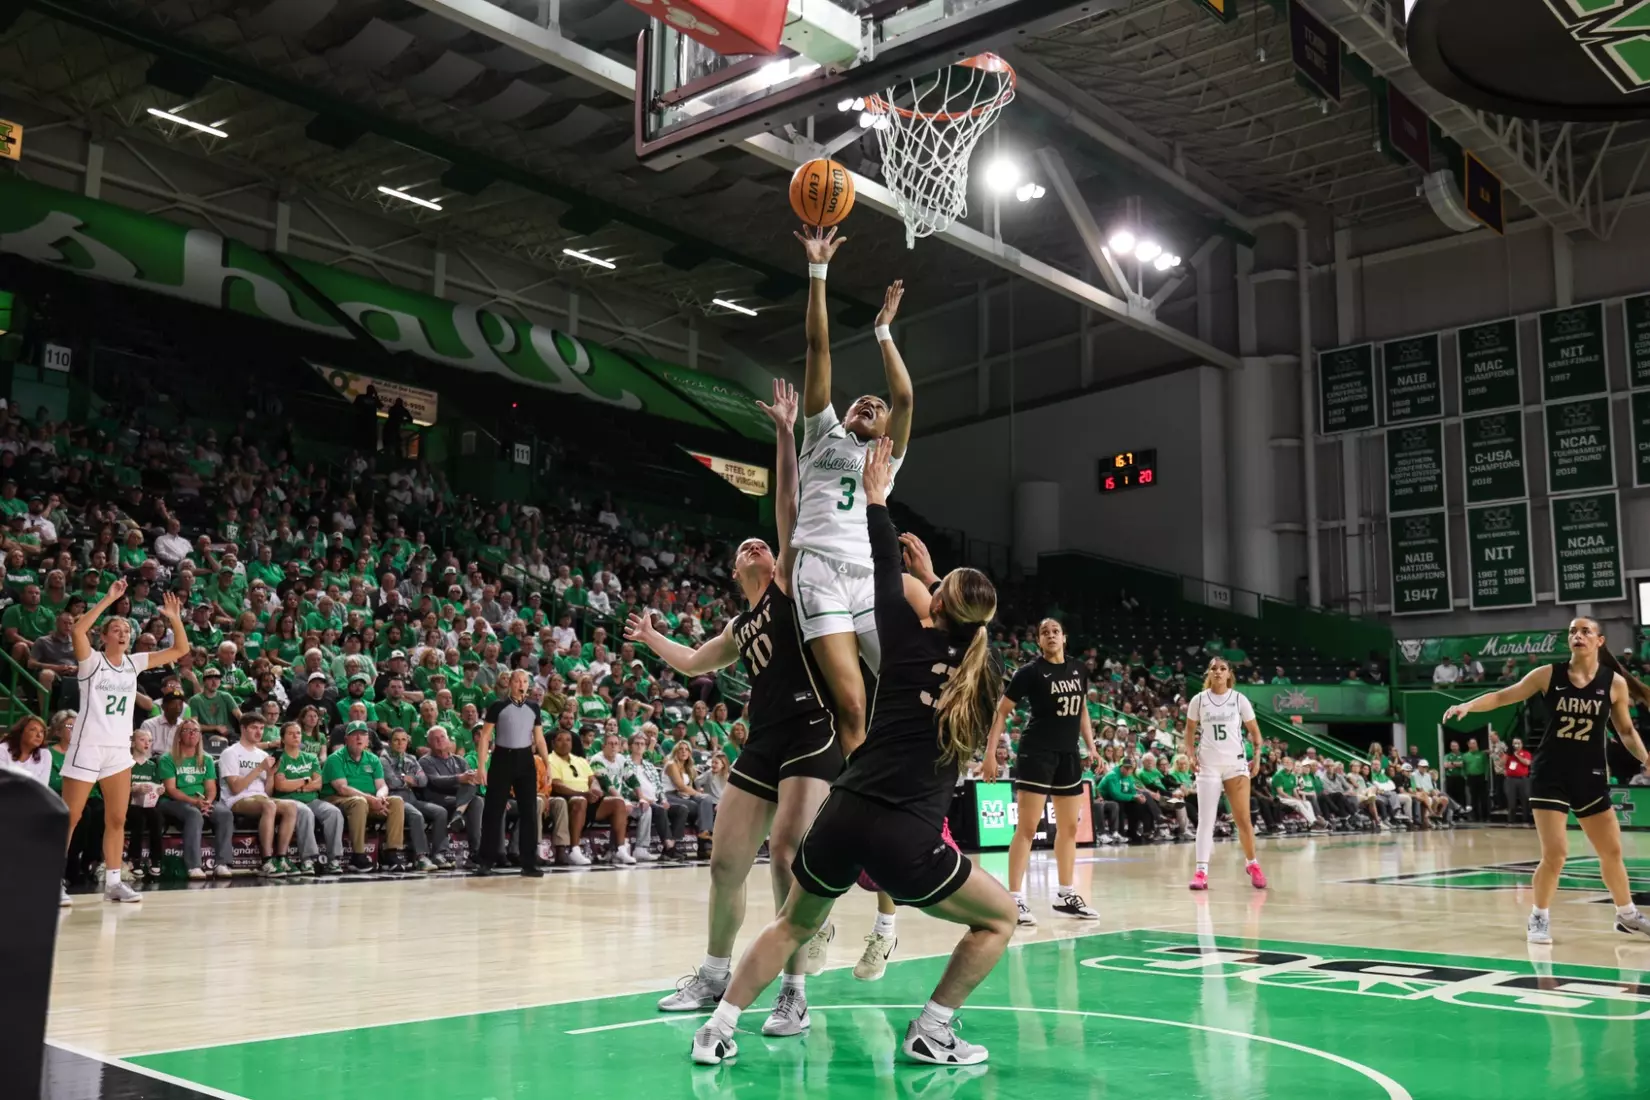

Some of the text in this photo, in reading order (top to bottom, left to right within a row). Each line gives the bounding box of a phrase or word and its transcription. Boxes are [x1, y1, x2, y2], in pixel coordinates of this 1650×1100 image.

[826, 168, 844, 213] Wilson
[47, 350, 70, 366] 110
[1561, 345, 1585, 359] NIT
[1474, 359, 1504, 373] MAC
[1397, 373, 1428, 386] NAIB
[1465, 368, 1515, 383] CHAMPIONS
[1560, 435, 1598, 449] NCAA
[516, 448, 529, 460] 111
[1475, 450, 1513, 464] C-USA
[1553, 445, 1607, 458] TOURNAMENT
[1574, 454, 1602, 463] ROUND
[813, 448, 865, 473] Marsh
[1469, 460, 1521, 474] CHAMPIONS
[724, 464, 756, 477] STEEL OF
[736, 477, 765, 489] VIRGINIA
[1105, 469, 1153, 490] 15 1 20
[837, 477, 857, 511] 3
[1568, 535, 1605, 549] NCAA
[1405, 553, 1434, 564] NAIB
[1485, 546, 1515, 561] NIT
[1560, 546, 1616, 558] TOURNAMENT
[1400, 563, 1441, 573] NATIONAL
[1396, 571, 1445, 583] CHAMPIONS
[1404, 588, 1439, 603] 1947
[736, 602, 773, 652] ARMY
[1478, 632, 1557, 656] Marshall
[744, 633, 774, 677] 10
[1050, 678, 1082, 695] ARMY
[105, 695, 128, 717] 24
[1056, 694, 1082, 717] 30
[1555, 696, 1604, 716] ARMY
[1212, 724, 1227, 742] 15
[1556, 715, 1594, 742] 22
